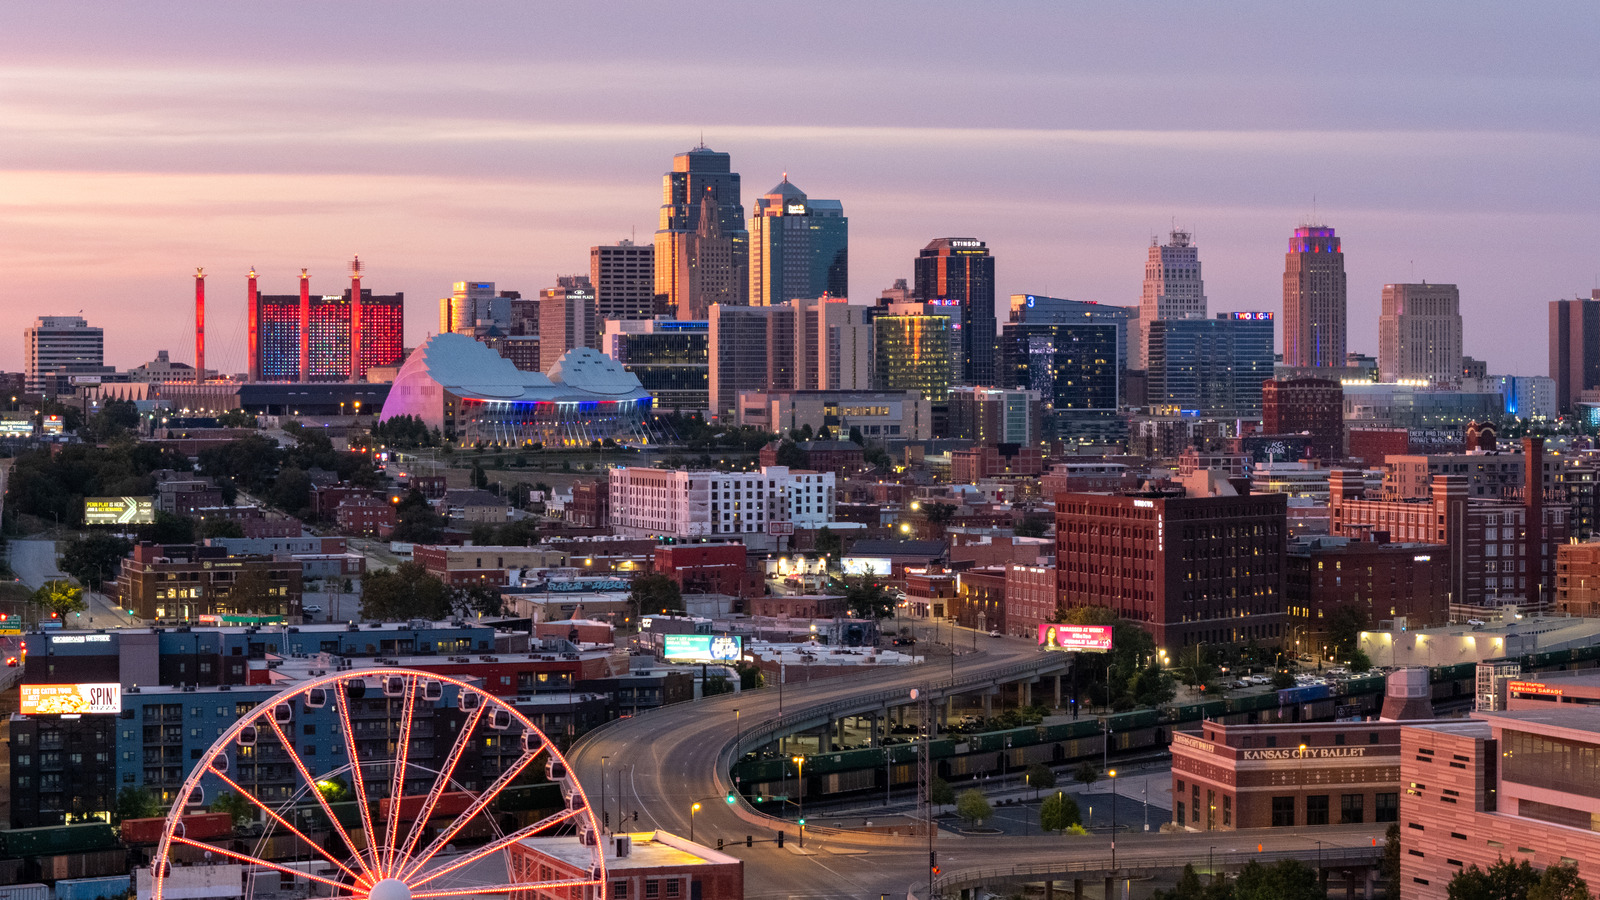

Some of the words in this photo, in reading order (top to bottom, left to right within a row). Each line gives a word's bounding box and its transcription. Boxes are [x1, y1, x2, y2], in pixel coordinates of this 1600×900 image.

[1027, 295, 1035, 308] 3
[1234, 312, 1251, 320] TWO
[1252, 312, 1274, 320] LIGHT
[90, 687, 117, 706] SPIN!
[1243, 750, 1290, 760] KANSAS
[1291, 748, 1319, 759] CITY
[1320, 747, 1366, 758] BALLET
